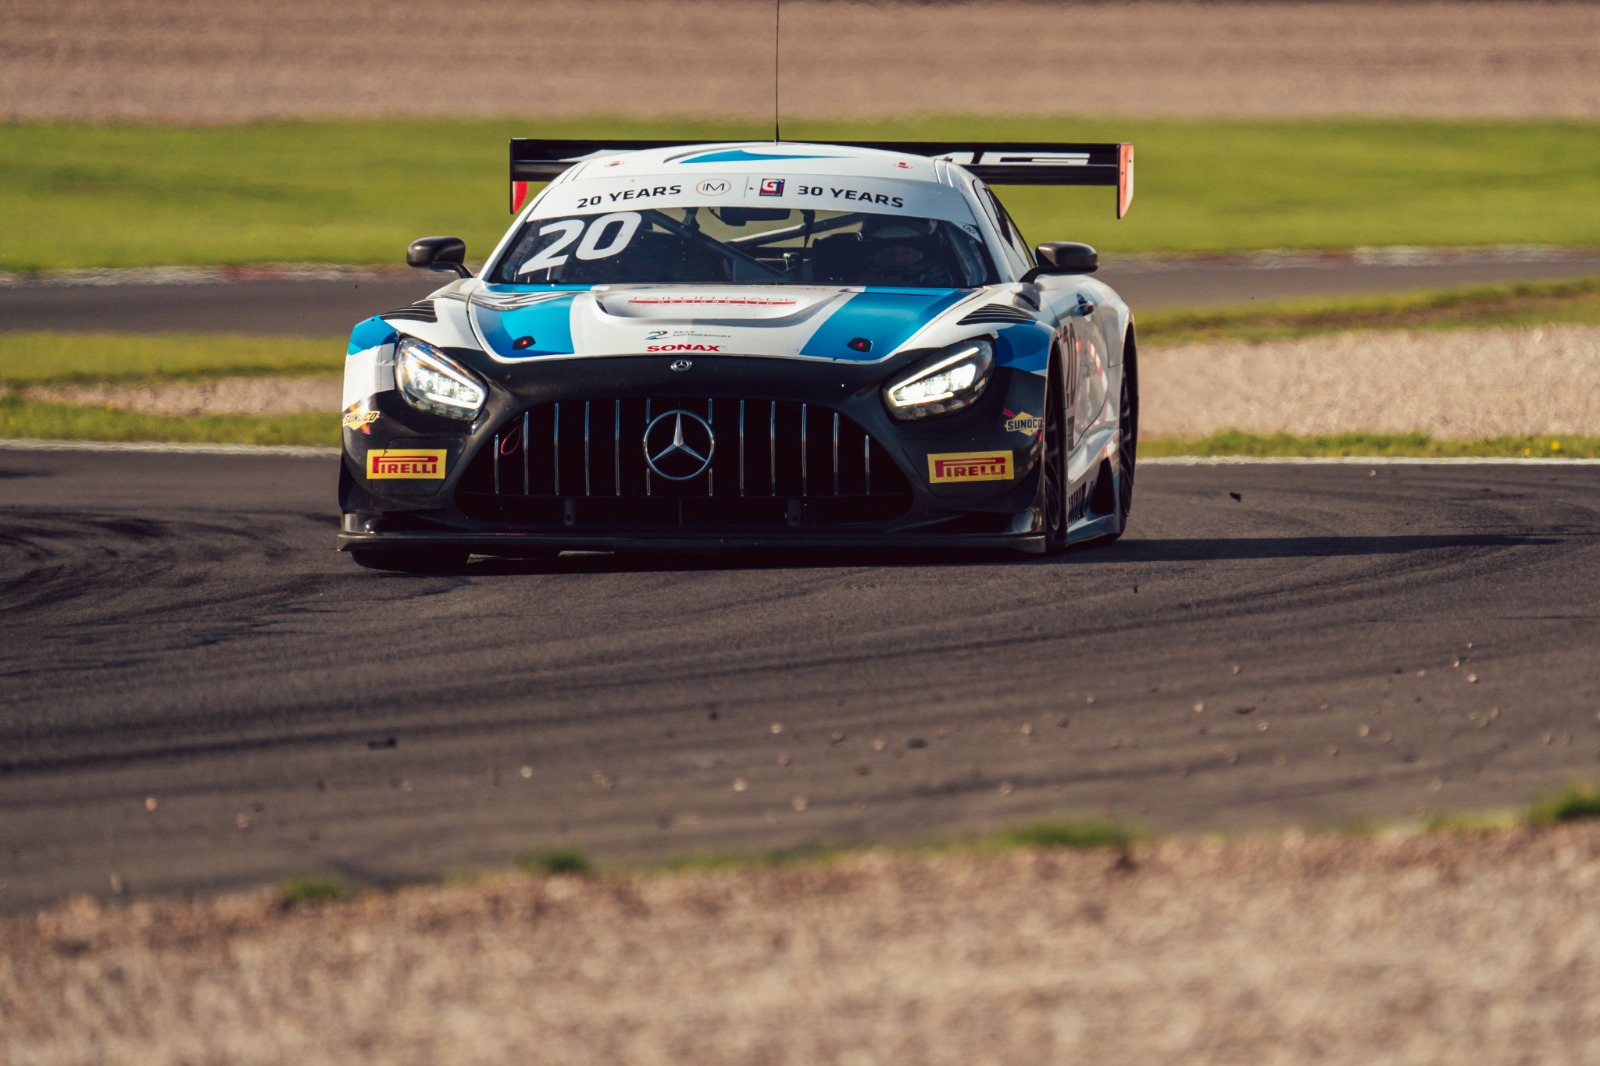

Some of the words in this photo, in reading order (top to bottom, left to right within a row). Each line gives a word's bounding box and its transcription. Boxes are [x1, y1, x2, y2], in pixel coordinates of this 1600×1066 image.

[577, 195, 602, 209] 20
[609, 184, 682, 202] YEARS
[798, 185, 823, 196] 30
[830, 187, 904, 208] YEARS
[518, 211, 642, 275] 20
[646, 344, 721, 352] SONAX
[372, 455, 438, 474] PIRELLI
[935, 457, 1006, 478] PIRELLI
